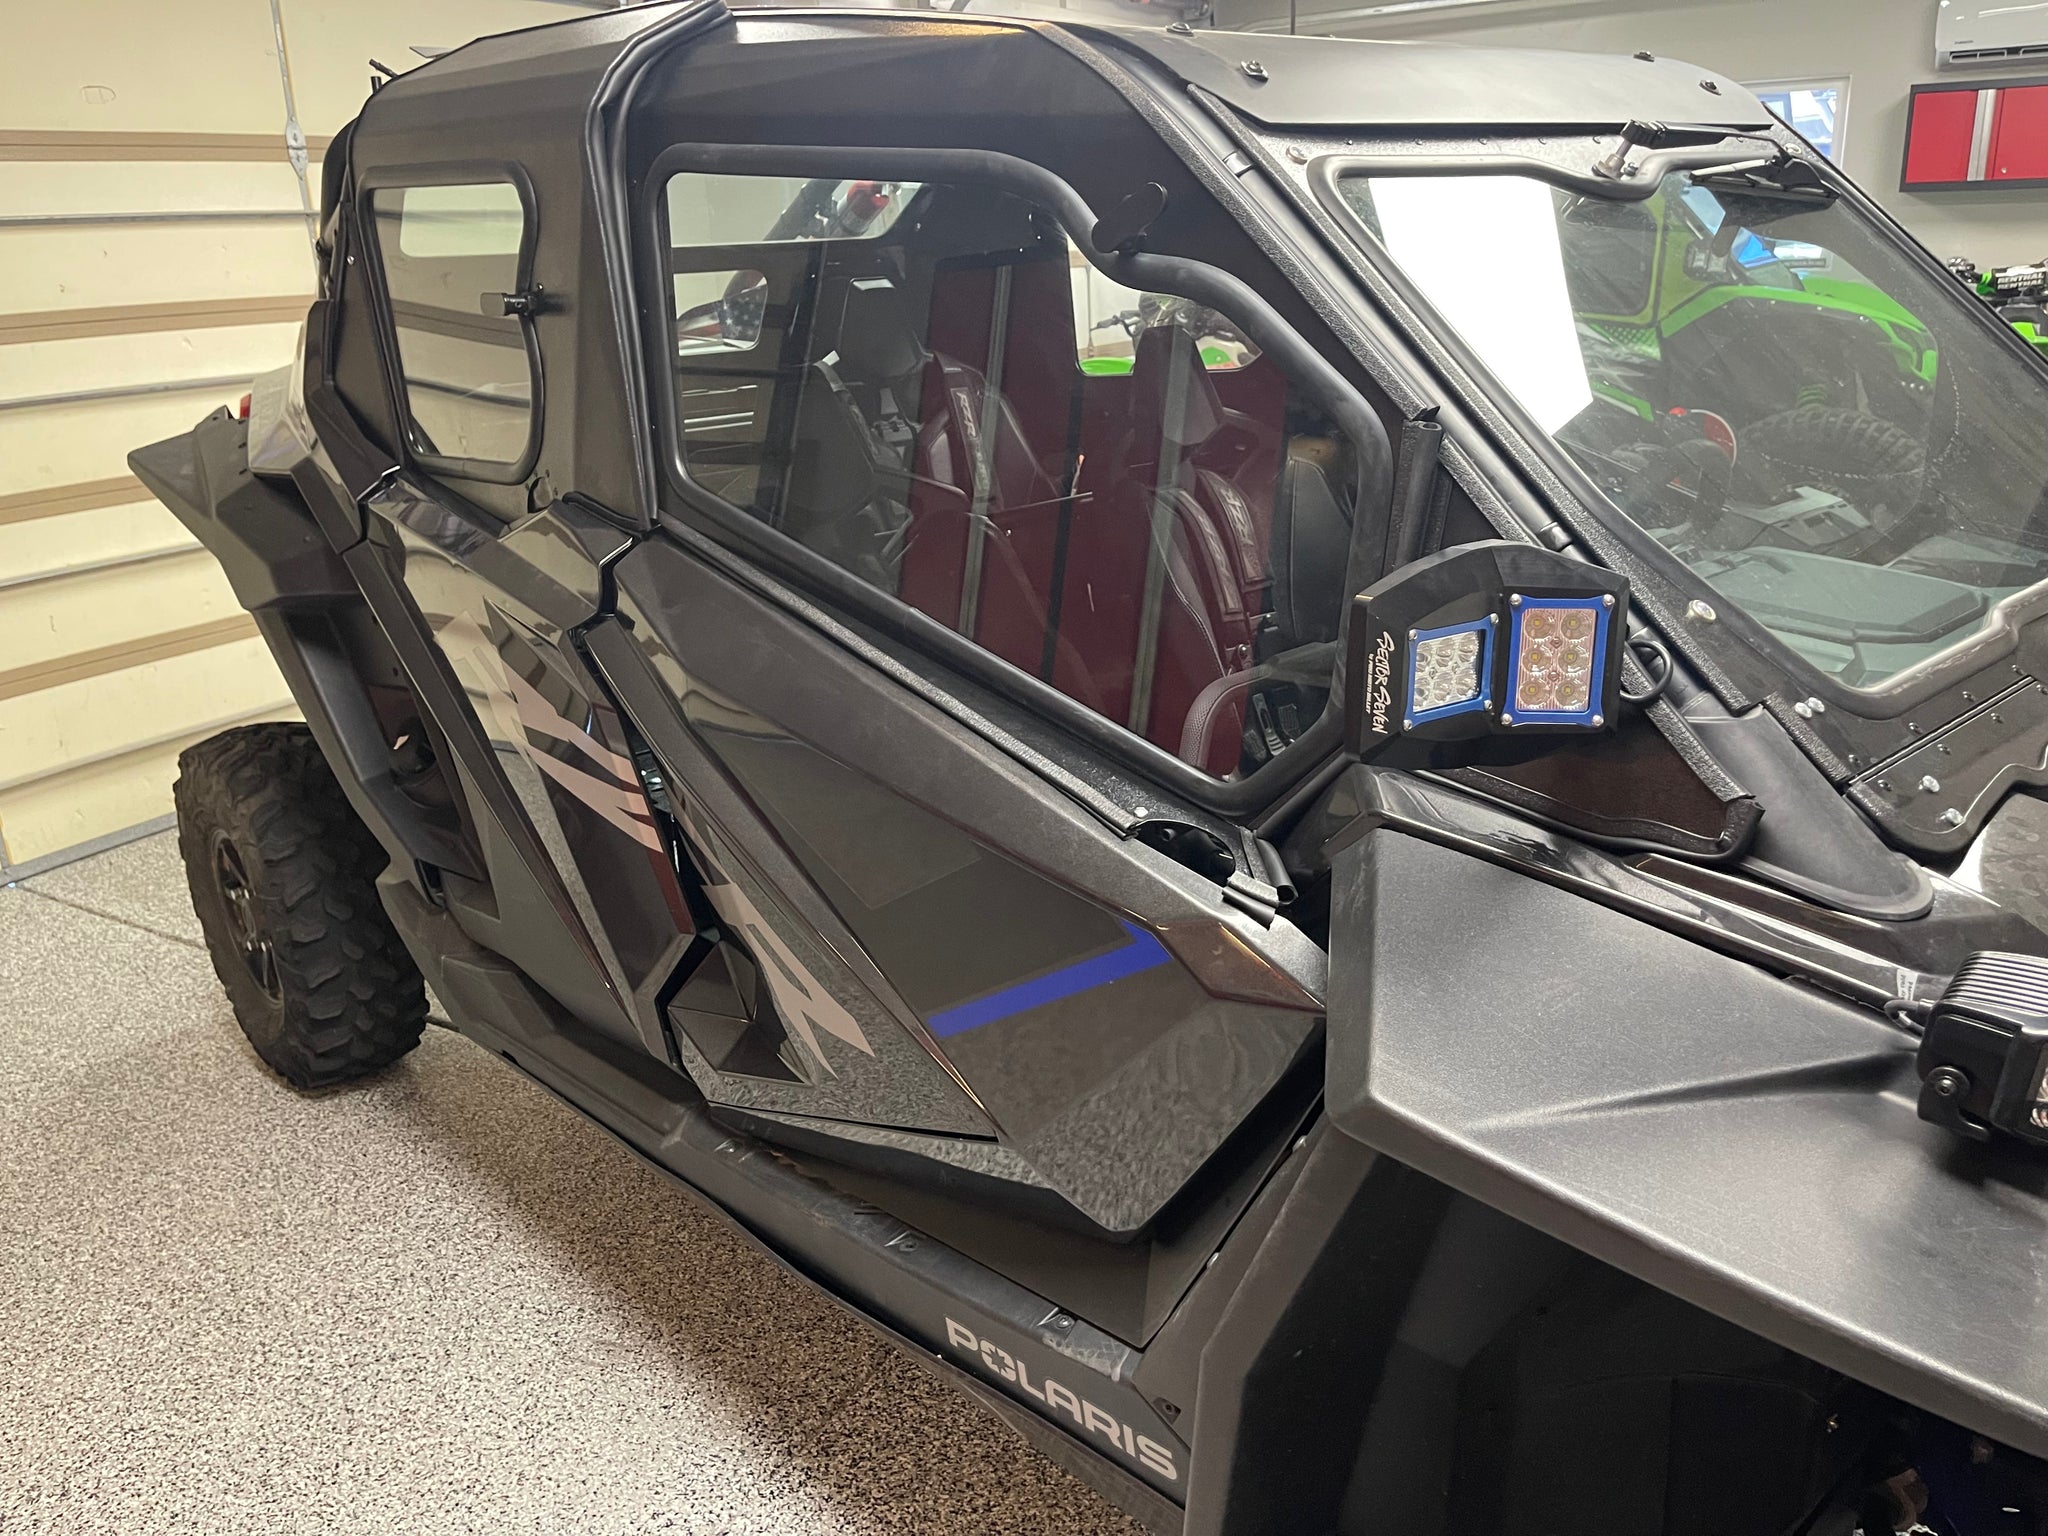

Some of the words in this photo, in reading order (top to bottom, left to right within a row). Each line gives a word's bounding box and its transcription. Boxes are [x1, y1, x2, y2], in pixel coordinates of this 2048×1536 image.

[956, 392, 976, 437] RZR
[1374, 631, 1395, 686] SECTOR
[1371, 685, 1392, 734] SEVEN
[945, 1316, 1178, 1480] POLARIS
